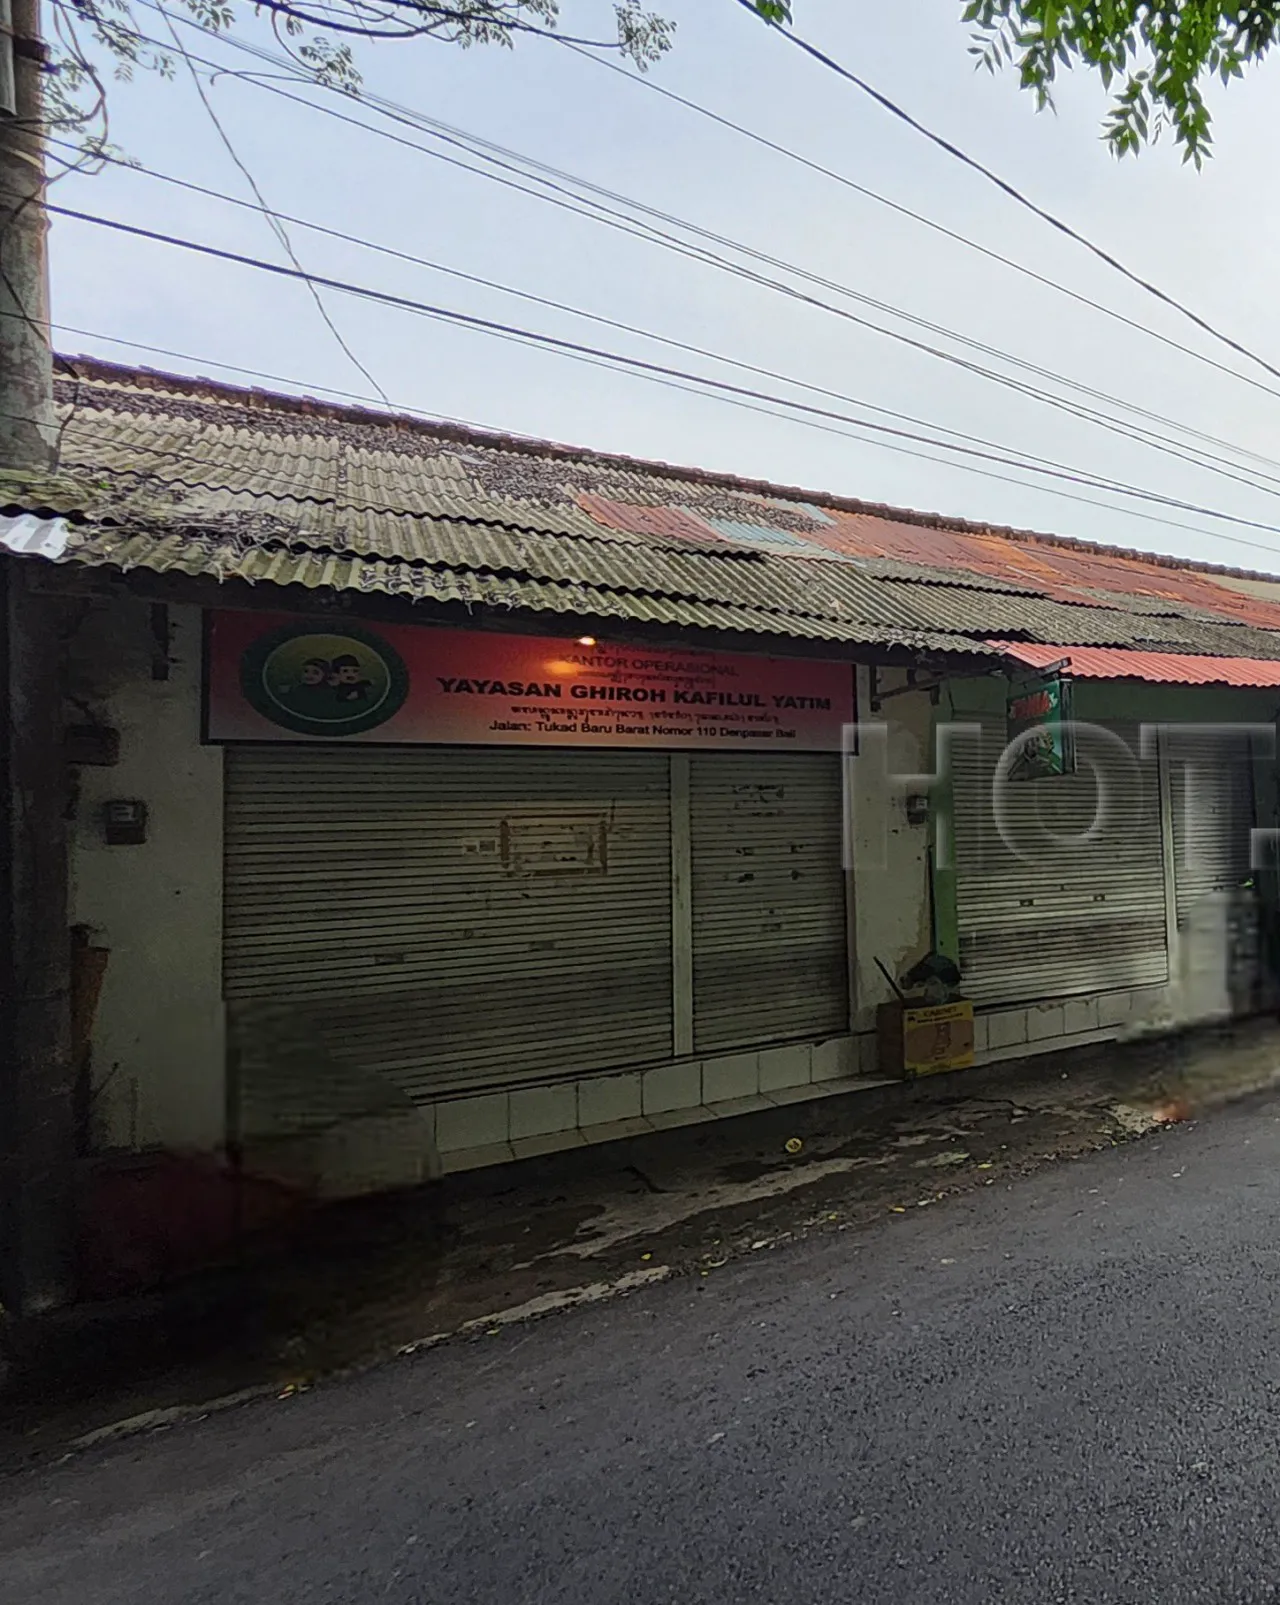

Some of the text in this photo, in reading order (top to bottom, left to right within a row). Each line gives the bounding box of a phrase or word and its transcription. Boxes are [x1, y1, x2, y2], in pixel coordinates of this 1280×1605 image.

[559, 654, 740, 677] KANTOR OPERASIONAL
[436, 677, 562, 698] YAYASAN
[570, 684, 666, 703] GHIROH
[673, 690, 767, 708] KAFILUL
[772, 695, 832, 711] YATIM
[536, 720, 577, 733] Tukad
[581, 722, 613, 734] Baru
[616, 723, 650, 736] Barat
[652, 724, 693, 737] Nomor
[696, 726, 717, 738] 110
